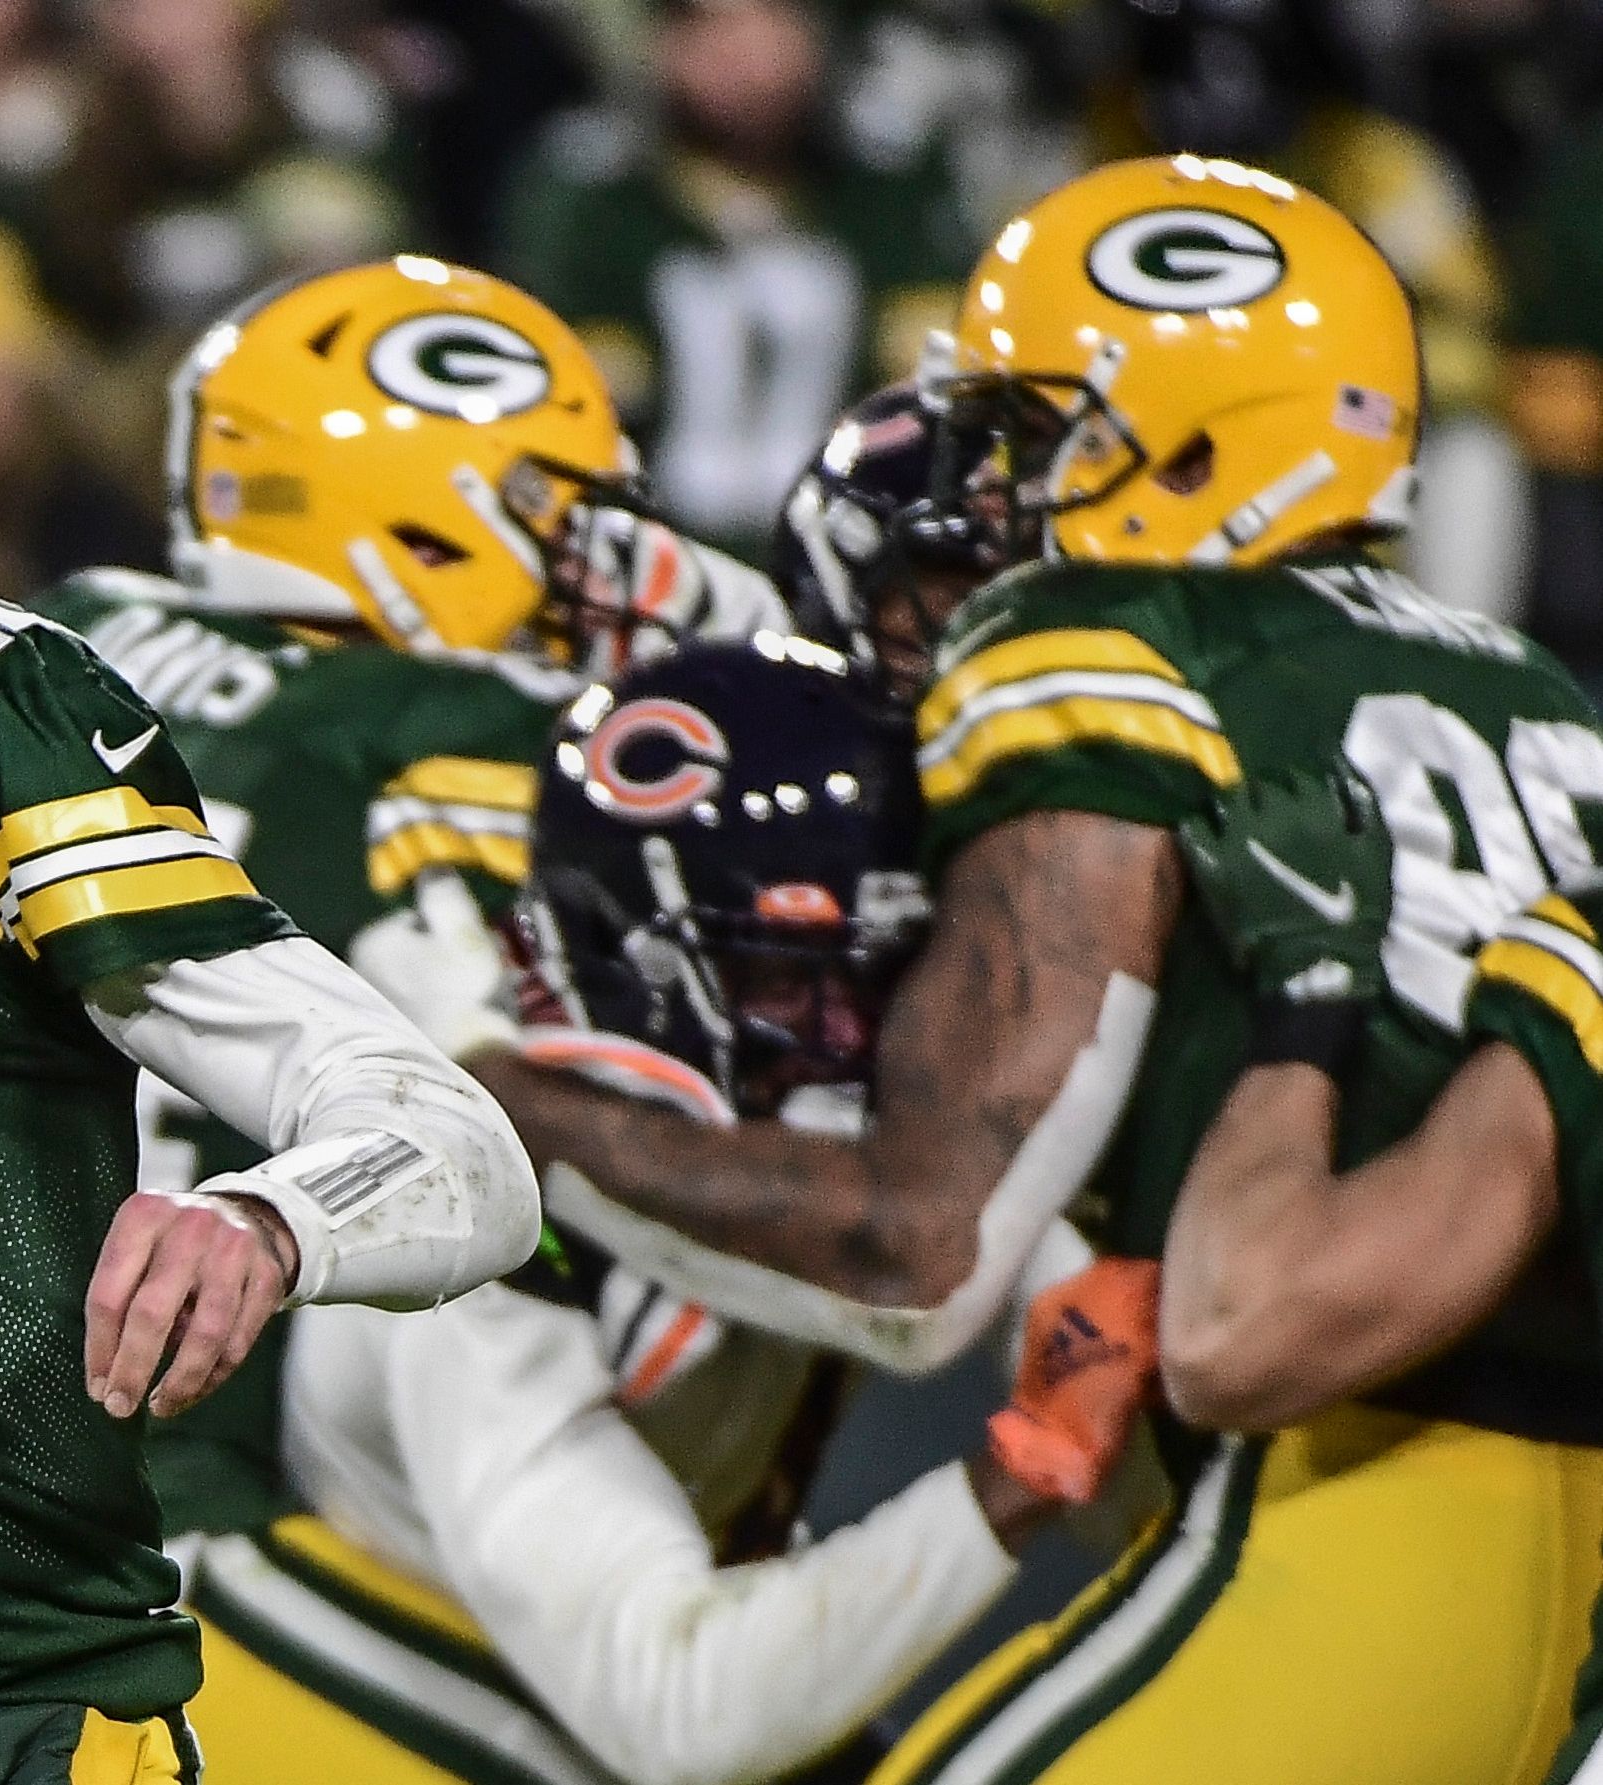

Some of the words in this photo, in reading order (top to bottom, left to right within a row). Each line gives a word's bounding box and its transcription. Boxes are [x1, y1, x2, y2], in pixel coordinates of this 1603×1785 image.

[1086, 209, 1282, 310] G
[368, 312, 549, 418] G
[584, 699, 731, 818] C
